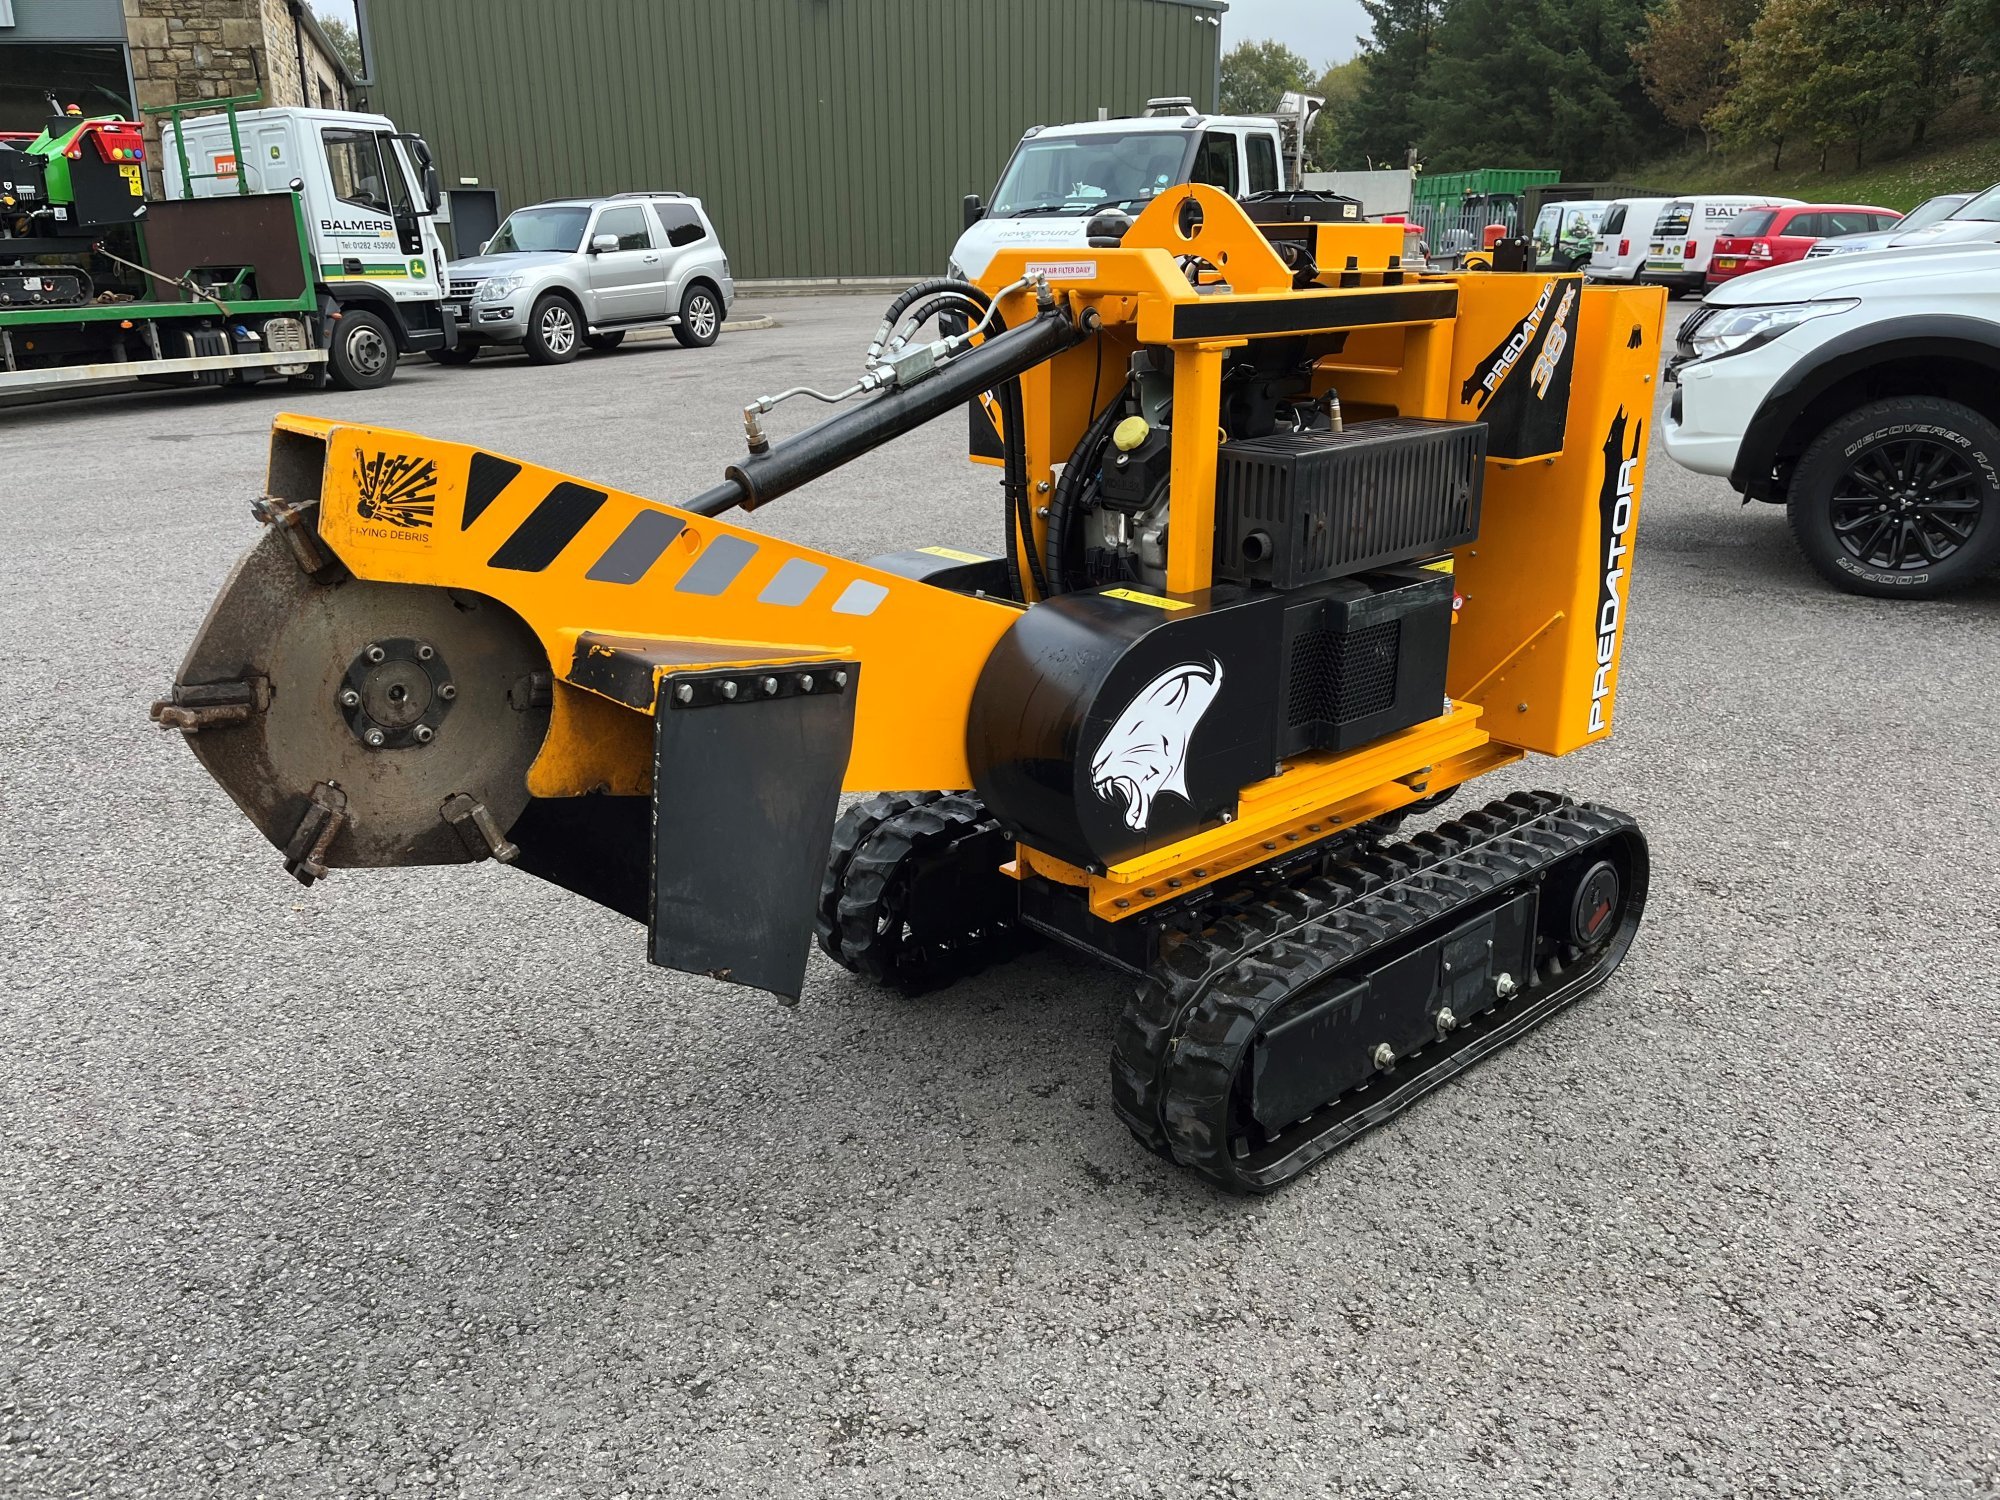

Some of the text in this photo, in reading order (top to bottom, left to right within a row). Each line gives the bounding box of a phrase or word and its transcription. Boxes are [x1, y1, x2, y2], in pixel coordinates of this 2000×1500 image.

[217, 162, 237, 173] STIH
[321, 220, 393, 230] BALMERS
[998, 229, 1080, 239] newground
[353, 242, 371, 250] 01282
[373, 242, 396, 250] 453900
[1058, 266, 1075, 274] FILTER
[1482, 282, 1553, 391] PREDATOR
[1845, 424, 1972, 457] DISCOVERER
[390, 530, 429, 543] DEBRIS
[1836, 557, 1928, 585] COOPER
[1588, 457, 1637, 735] PREDATOR
